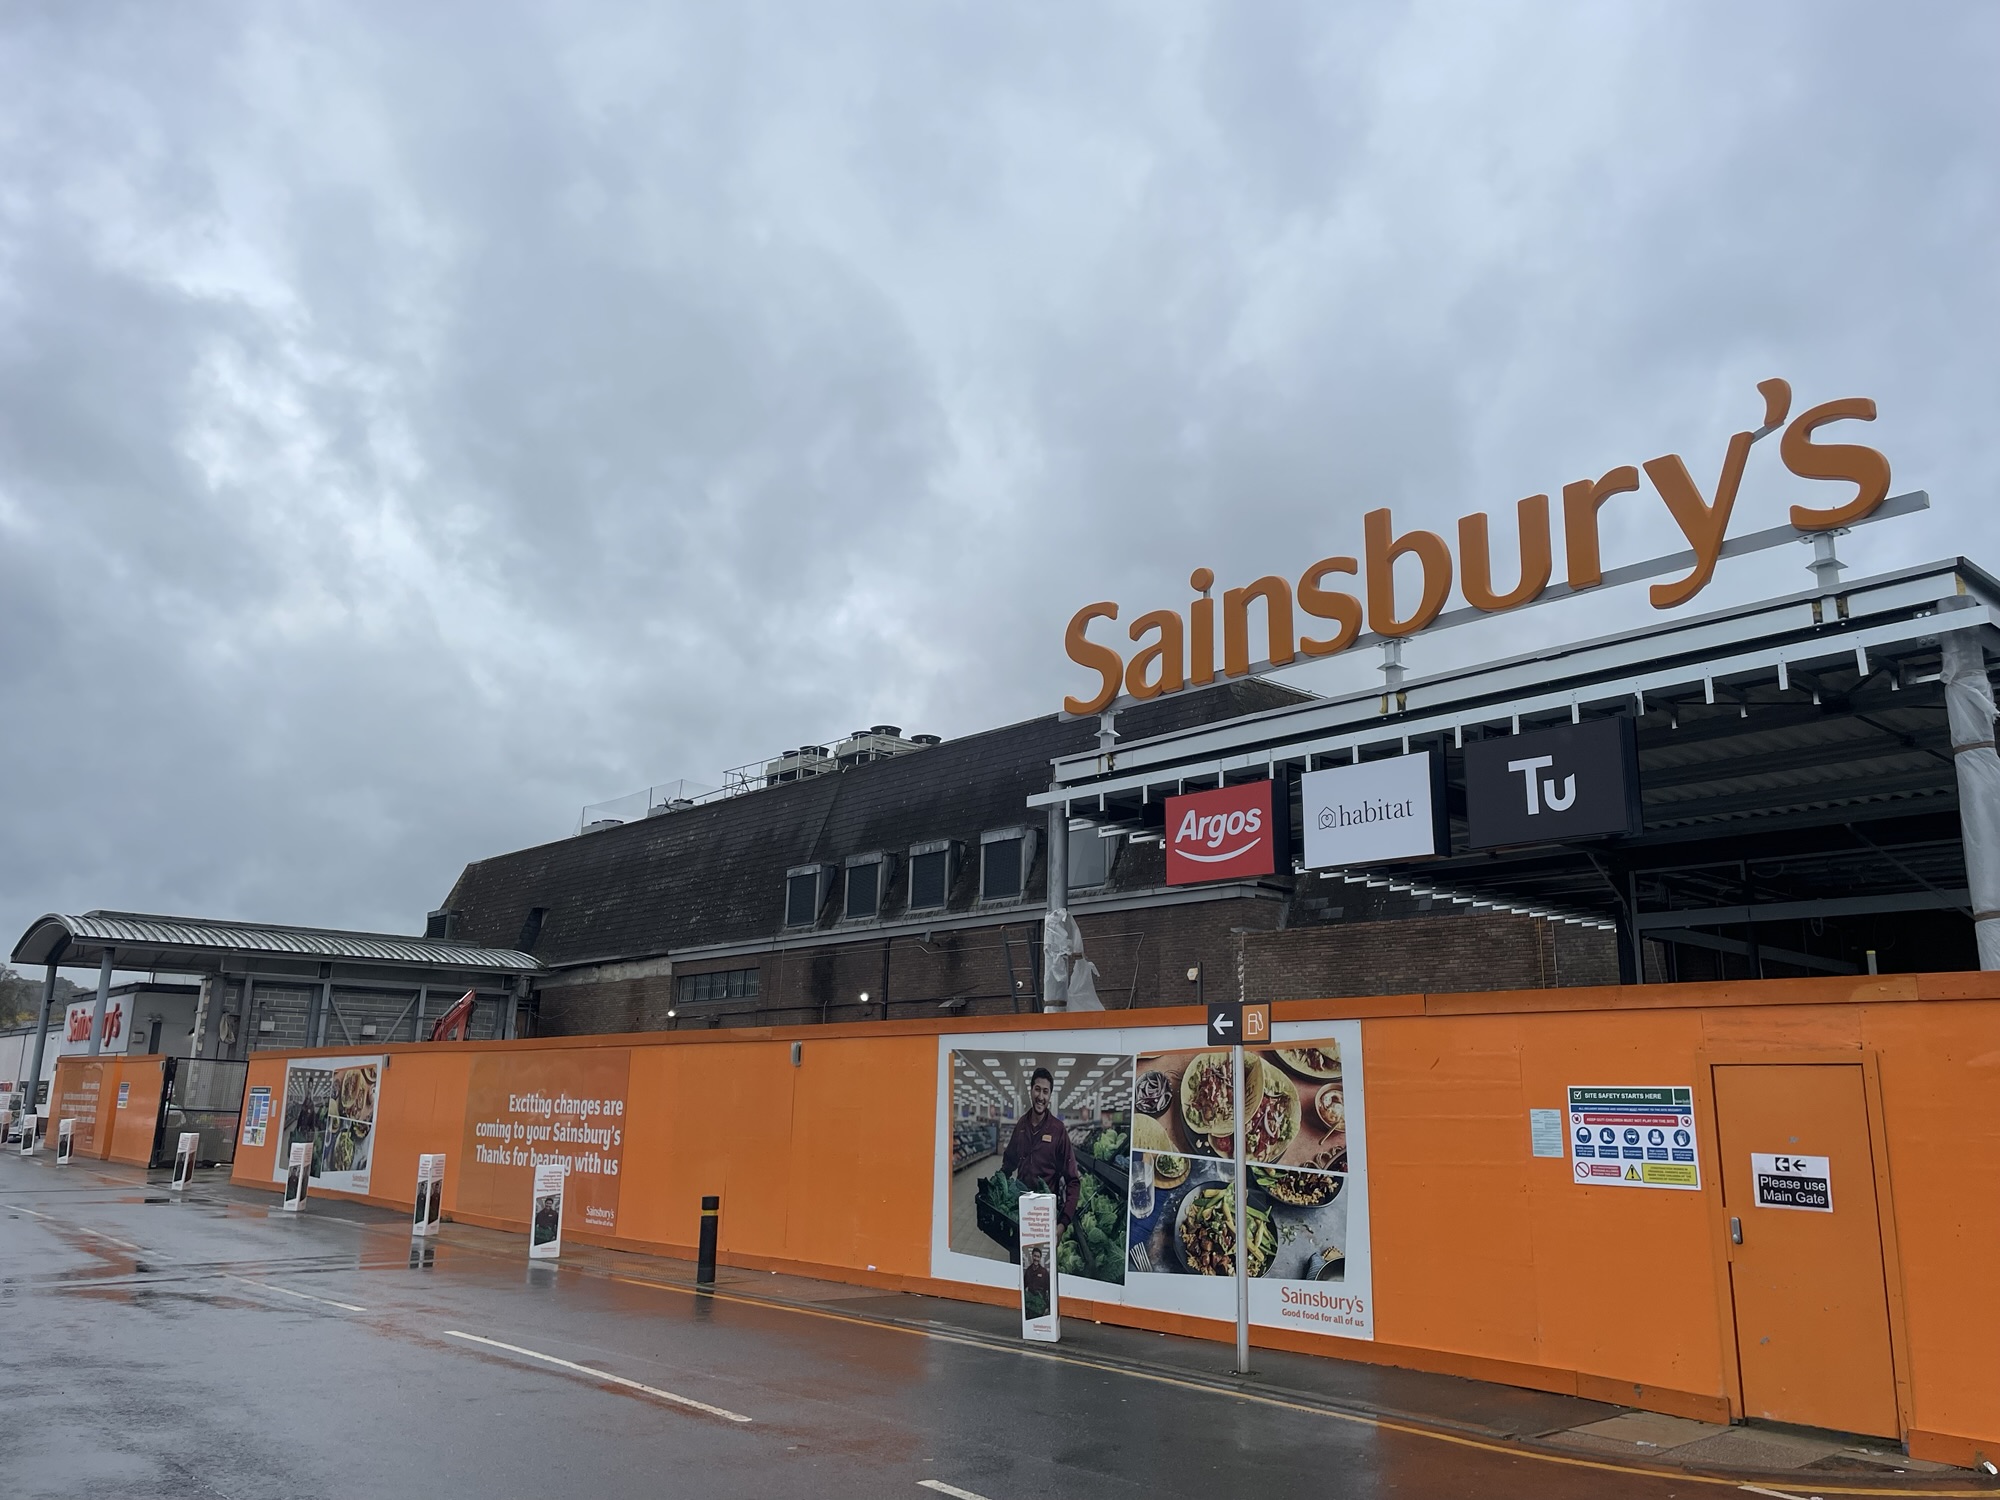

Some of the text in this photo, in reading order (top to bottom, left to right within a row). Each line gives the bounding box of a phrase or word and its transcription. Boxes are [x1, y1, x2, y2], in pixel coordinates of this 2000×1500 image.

[1063, 377, 1892, 717] Sainsbury's
[1507, 755, 1577, 816] Tu
[1174, 806, 1263, 848] Argos
[1338, 798, 1415, 828] habitat
[67, 1003, 122, 1047] Sainsry's
[509, 1093, 623, 1121] Exciting changes are
[475, 1119, 621, 1151] coming to your Sainsbury's
[476, 1144, 618, 1177] Thanks for bearing with us
[1760, 1175, 1826, 1192] Please use
[1763, 1189, 1825, 1205] Main Gate
[586, 1205, 615, 1221] Sainsbury's
[1281, 1286, 1364, 1315] Sainsbury's
[1281, 1308, 1364, 1327] Good food for all of us
